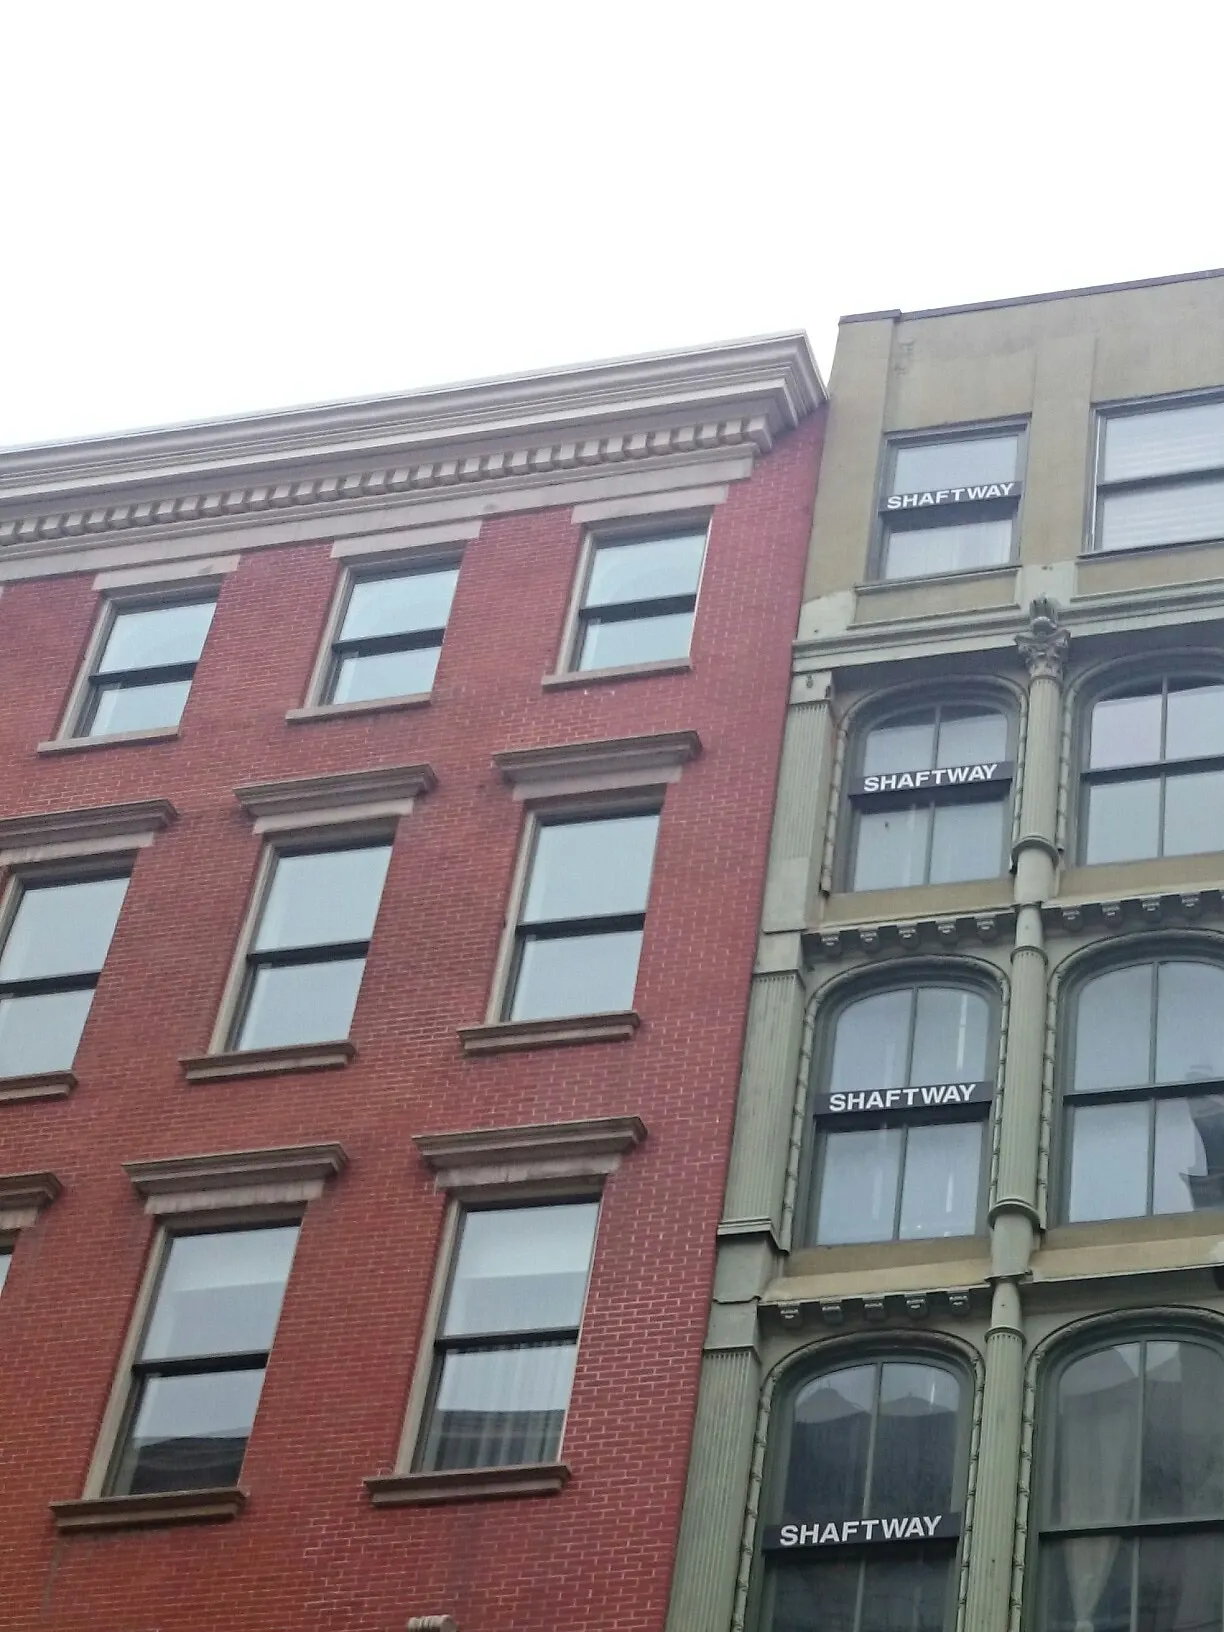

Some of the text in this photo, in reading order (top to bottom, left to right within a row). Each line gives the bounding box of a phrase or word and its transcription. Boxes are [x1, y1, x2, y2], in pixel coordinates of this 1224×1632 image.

[887, 482, 1015, 509] SHAFTWAY
[863, 763, 998, 792] SHAFTWAY
[829, 1083, 976, 1112] SHAFTWAY
[779, 1515, 942, 1546] SHAFTWAY
